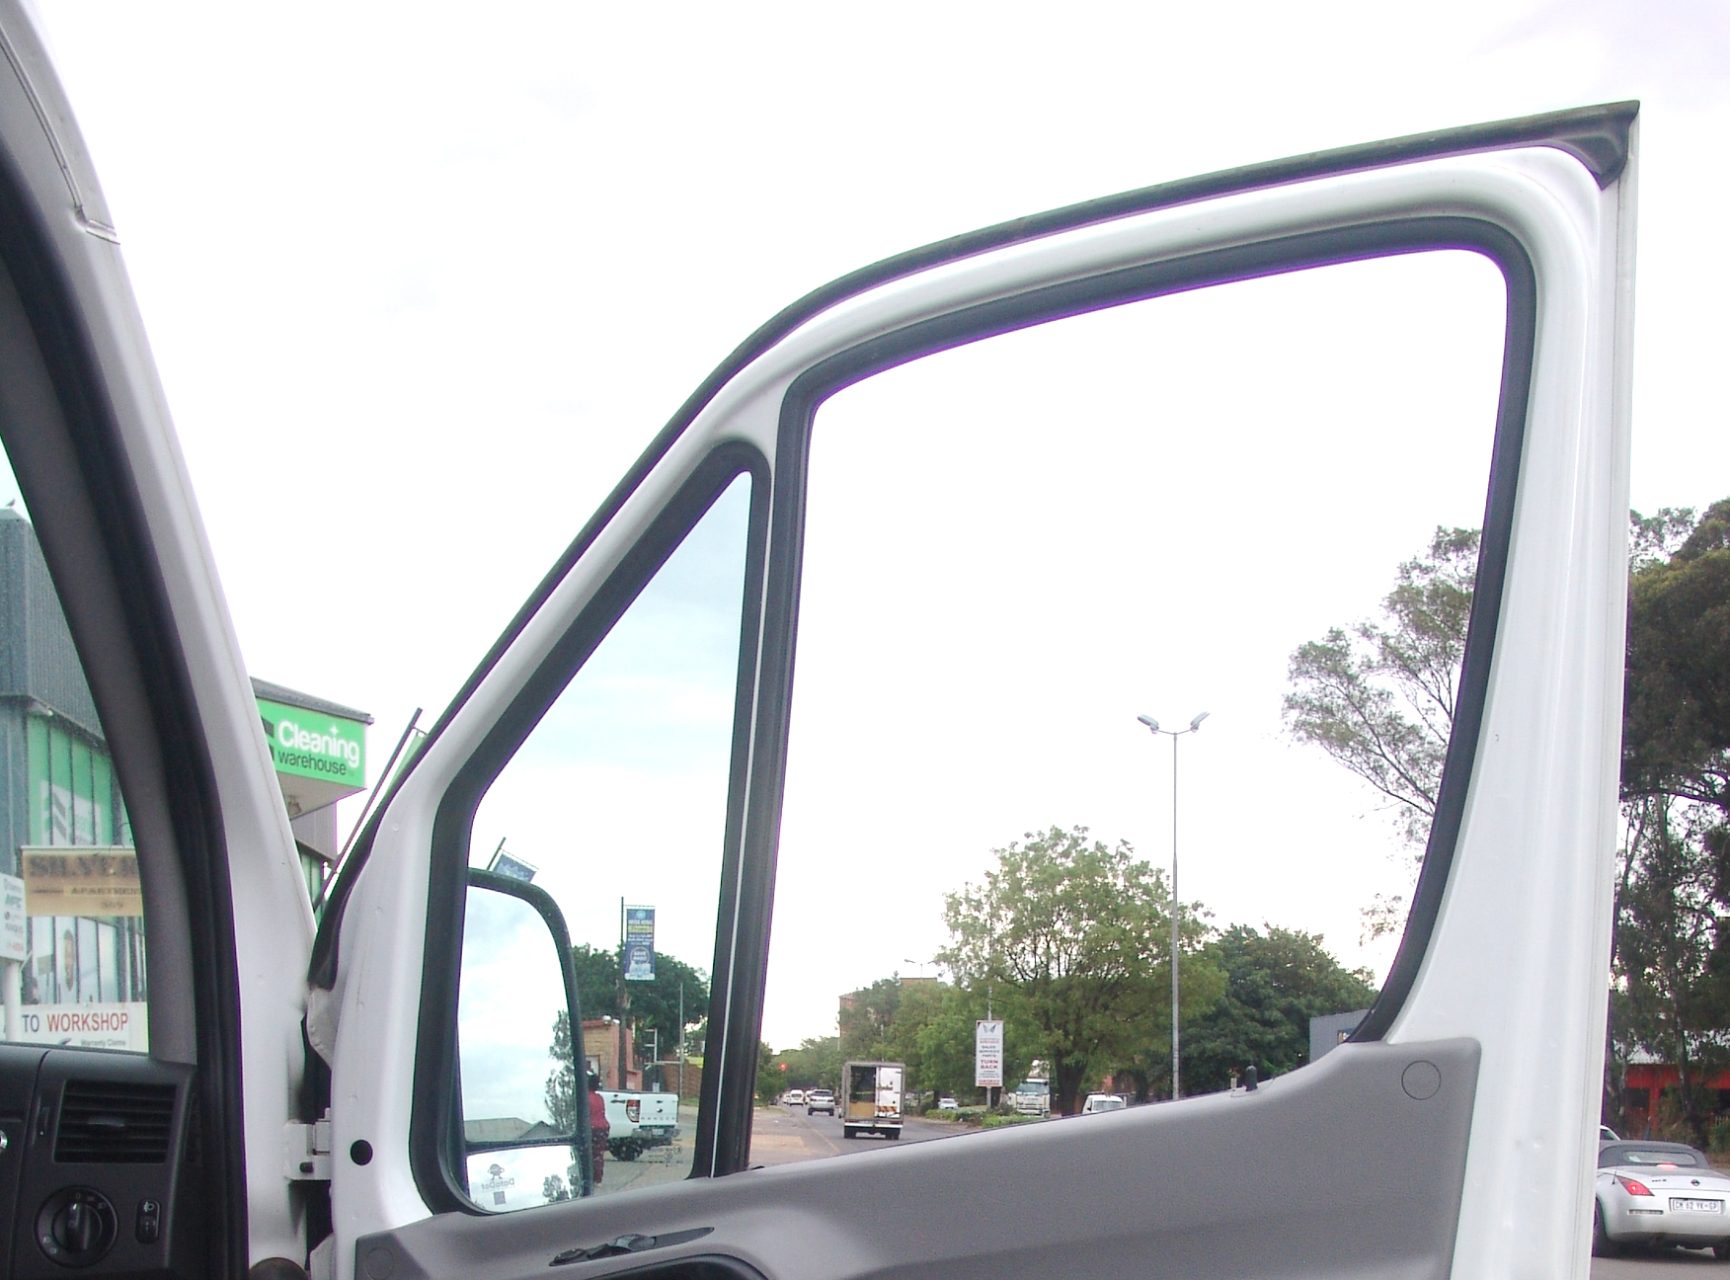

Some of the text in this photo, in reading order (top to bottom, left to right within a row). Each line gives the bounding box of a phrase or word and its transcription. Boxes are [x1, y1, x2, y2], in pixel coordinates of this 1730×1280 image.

[278, 720, 360, 768] Cleaning
[278, 751, 347, 776] warehouse
[22, 1013, 128, 1032] TO WORKSHOP
